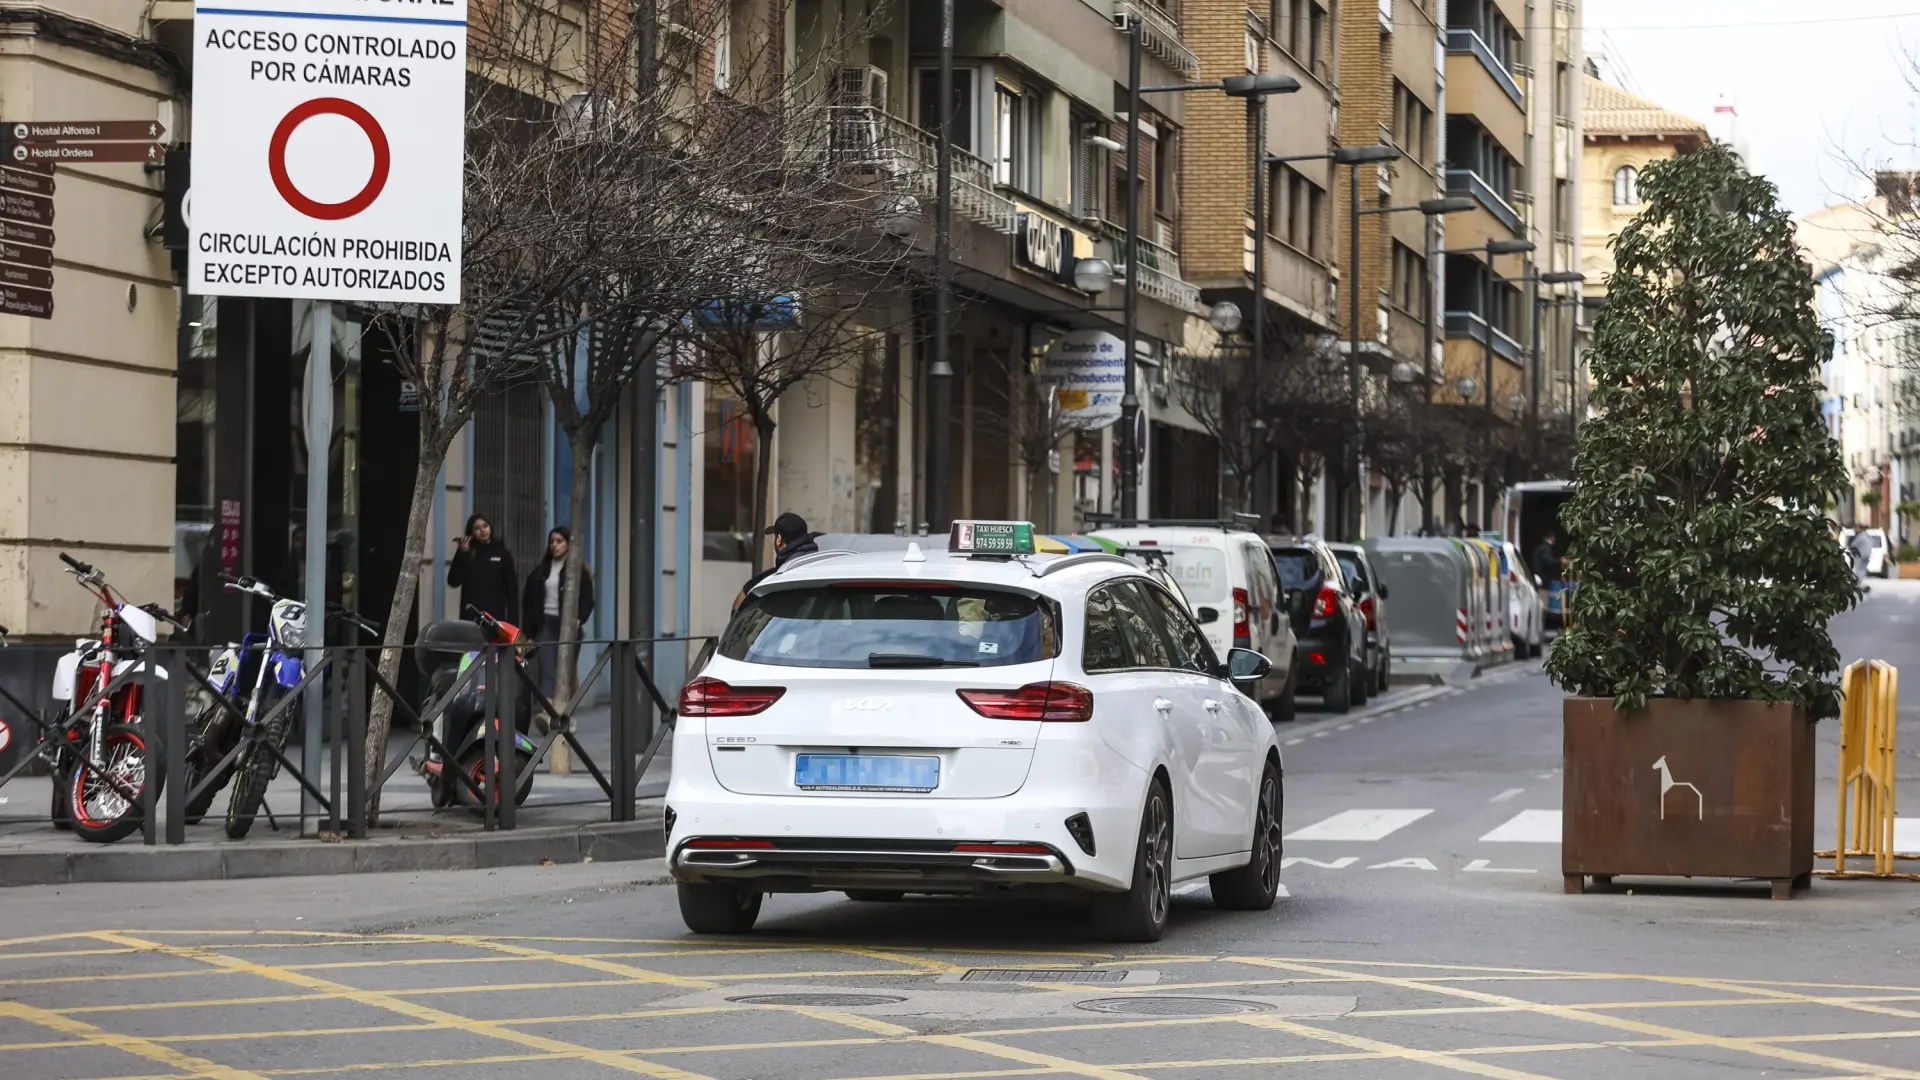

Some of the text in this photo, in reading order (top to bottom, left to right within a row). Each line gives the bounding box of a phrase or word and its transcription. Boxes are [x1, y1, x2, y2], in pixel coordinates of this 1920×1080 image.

[206, 29, 456, 60] ACCESO CONTROLADO
[251, 59, 411, 87] POR CÁMARAS
[31, 125, 61, 136] Hostal
[62, 124, 96, 136] Alfonso
[31, 147, 94, 158] Hostal Ordesa
[199, 231, 452, 263] CIRCULACIÓN PROHIBIDA
[204, 262, 445, 292] EXCEPTO AUTORIZADOS
[1062, 341, 1113, 353] Centro de
[975, 525, 1014, 534] TAXI HUESCA
[975, 537, 1014, 549] 974 59 59 59
